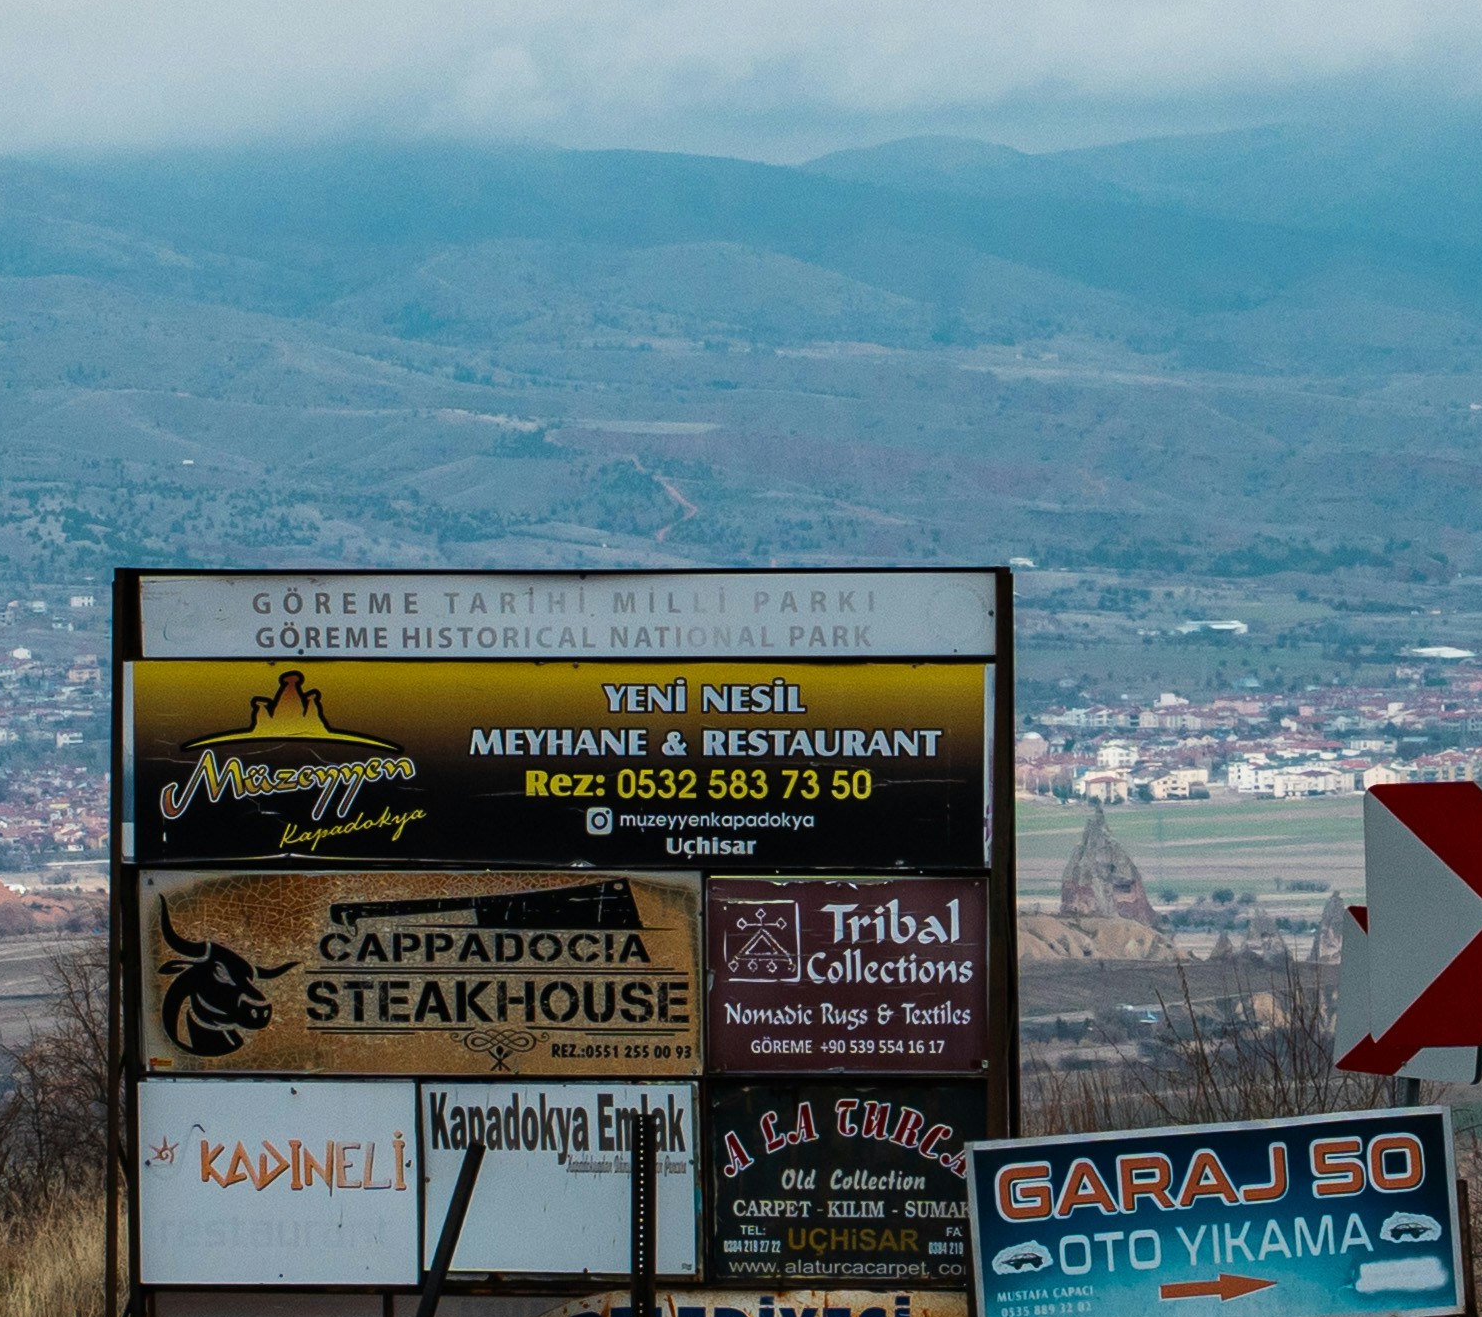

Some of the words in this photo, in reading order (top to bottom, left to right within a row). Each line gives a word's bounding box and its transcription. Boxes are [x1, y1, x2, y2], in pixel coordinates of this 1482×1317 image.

[252, 586, 419, 615] GÖREME
[753, 589, 876, 613] PARKI
[255, 622, 388, 650] GÖREME
[402, 625, 595, 649] HISTORICAL
[610, 624, 775, 649] NATIONAL
[788, 624, 873, 648] PARK
[604, 678, 686, 713] YENİ
[702, 678, 806, 713] NESİL
[469, 728, 647, 756] MEYHANE
[661, 730, 687, 757] &
[702, 729, 942, 757] RESTAURANT
[160, 749, 416, 820] Müzeyyen
[525, 769, 606, 797] Rez:
[617, 768, 697, 799] 0532
[708, 769, 769, 799] 583
[782, 769, 820, 800] 73
[831, 769, 872, 800] 50
[279, 806, 427, 851] Kapadokya
[619, 812, 815, 830] muzeyyenkapadokya
[820, 898, 960, 944] Tribal
[320, 932, 651, 964] CAPPADOCIA
[807, 948, 973, 983] Collections
[306, 980, 690, 1023] STEAKHOUSE
[724, 1002, 813, 1025] Nomadic
[820, 1002, 868, 1030] Rugs
[900, 1001, 971, 1025] Textiles
[624, 1044, 650, 1059] 255
[654, 1044, 671, 1059] 00
[676, 1044, 692, 1059] 93
[751, 1036, 813, 1055] GÖREME
[820, 1039, 846, 1054] +90
[849, 1039, 875, 1054] 539
[879, 1039, 904, 1054] 554
[908, 1039, 925, 1054] 16
[929, 1039, 945, 1054] 17
[429, 1092, 590, 1165] Kapadokya
[724, 1131, 754, 1178] A
[760, 1101, 819, 1154] LA
[200, 1131, 406, 1196] KADINELİ
[994, 1142, 1288, 1223] GARAJ
[1310, 1133, 1425, 1198] 50
[781, 1169, 816, 1190] Old
[830, 1169, 926, 1190] Collection
[733, 1200, 812, 1218] CARPET
[827, 1201, 885, 1218] KILIM
[740, 1225, 766, 1236] TEL:
[946, 1226, 963, 1237] FA
[1059, 1229, 1161, 1276] OTO
[1176, 1214, 1374, 1266] YIKAMA
[939, 1262, 966, 1275] co
[997, 1288, 1048, 1302] MUSTAFA
